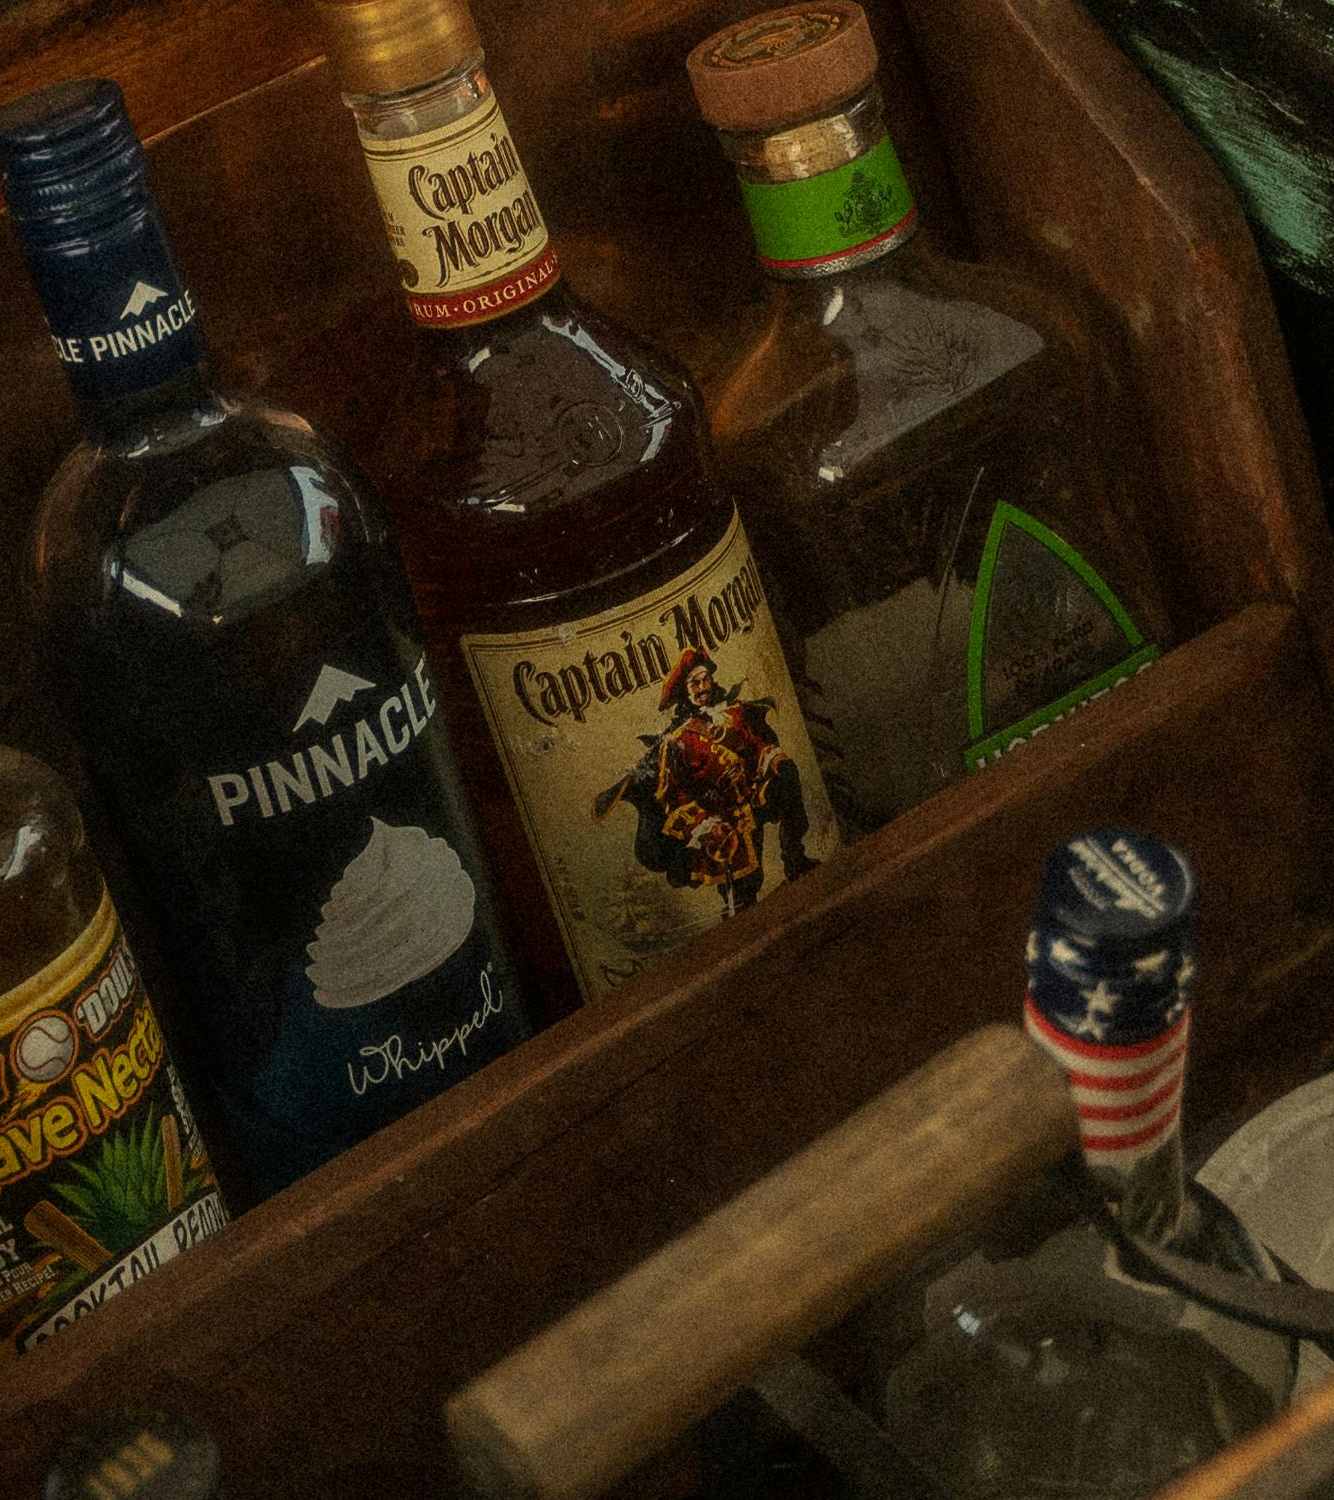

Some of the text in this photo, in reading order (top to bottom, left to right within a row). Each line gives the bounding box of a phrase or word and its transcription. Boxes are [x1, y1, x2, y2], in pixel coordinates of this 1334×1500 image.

[408, 132, 520, 221] Captain
[88, 289, 196, 364] PINNACLE
[513, 628, 671, 727] Captain
[206, 653, 437, 827] PINNACLE
[79, 1008, 163, 1128] Necta
[346, 970, 506, 1097] Whipped
